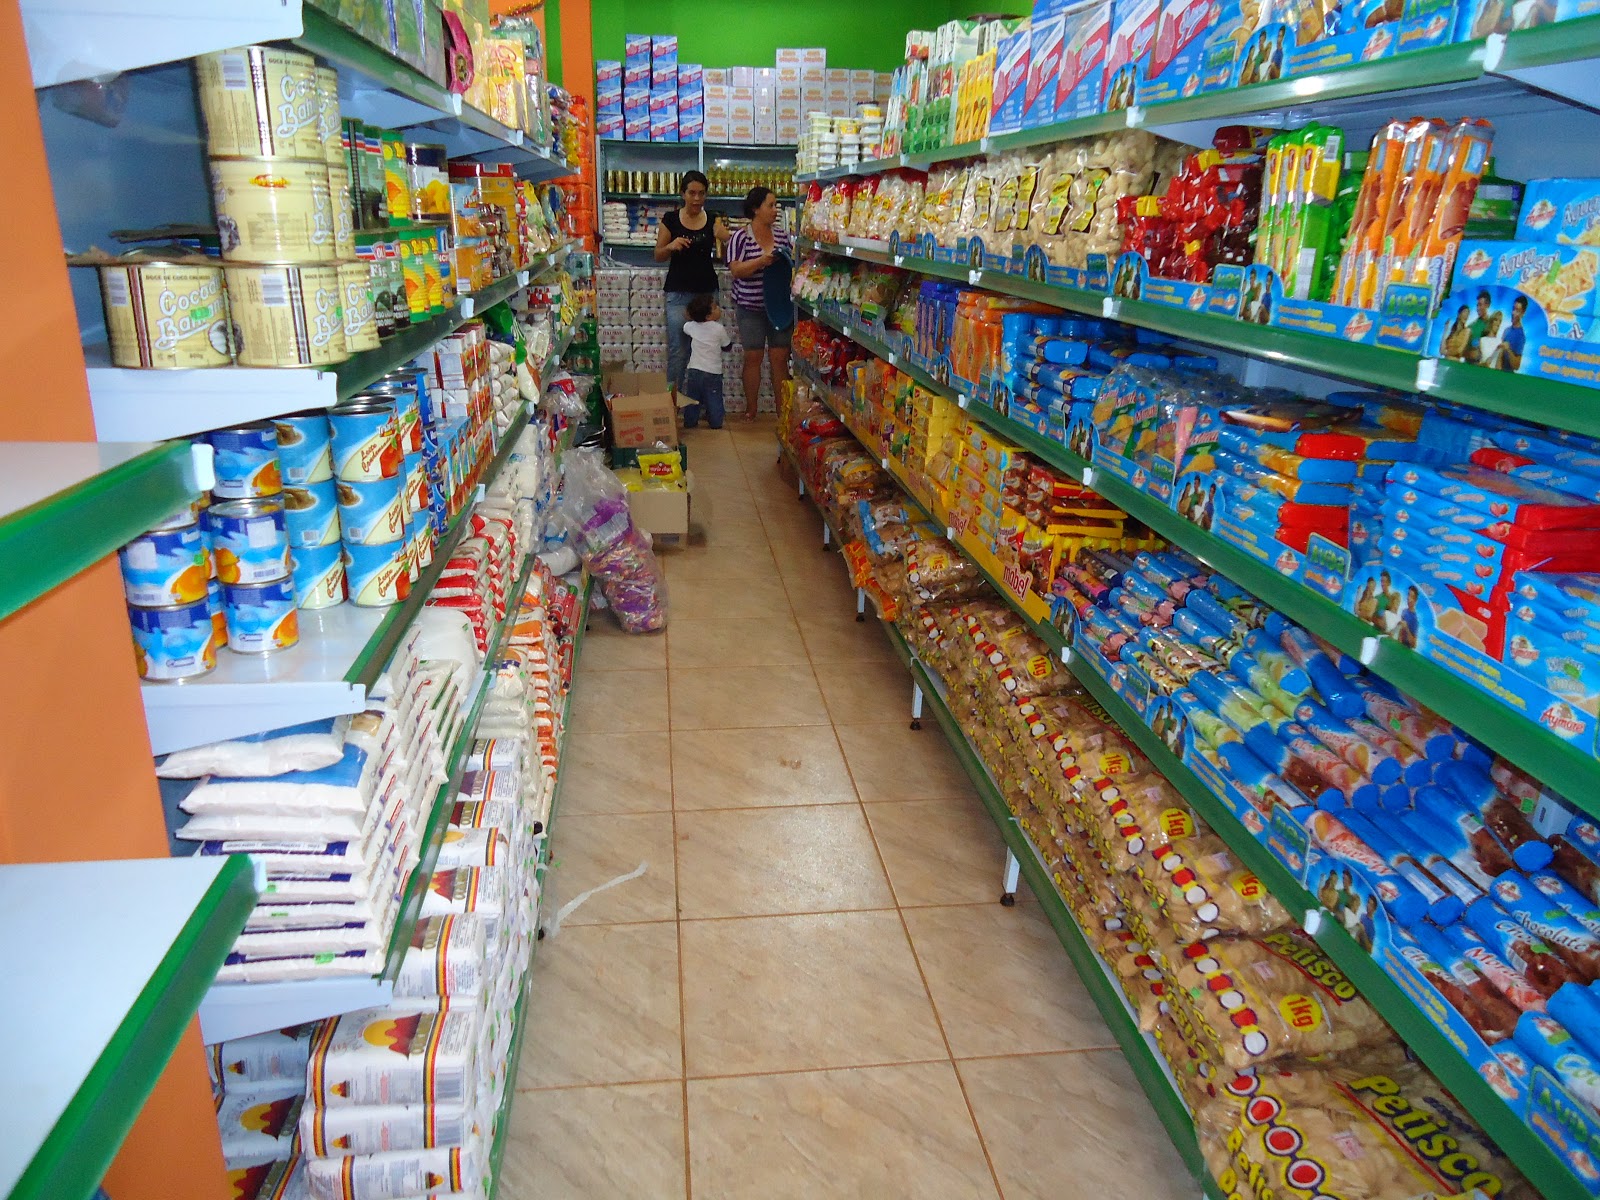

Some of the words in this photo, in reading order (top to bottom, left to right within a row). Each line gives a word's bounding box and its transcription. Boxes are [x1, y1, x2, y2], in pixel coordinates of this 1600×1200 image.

[1003, 565, 1030, 598] mabel
[1031, 656, 1048, 677] 1kg
[1166, 811, 1187, 836] 1kg
[1512, 910, 1589, 953] Chocolate
[1263, 933, 1357, 1003] Petisco
[1287, 997, 1314, 1029] 1kg
[1349, 1074, 1503, 1200] Petisco
